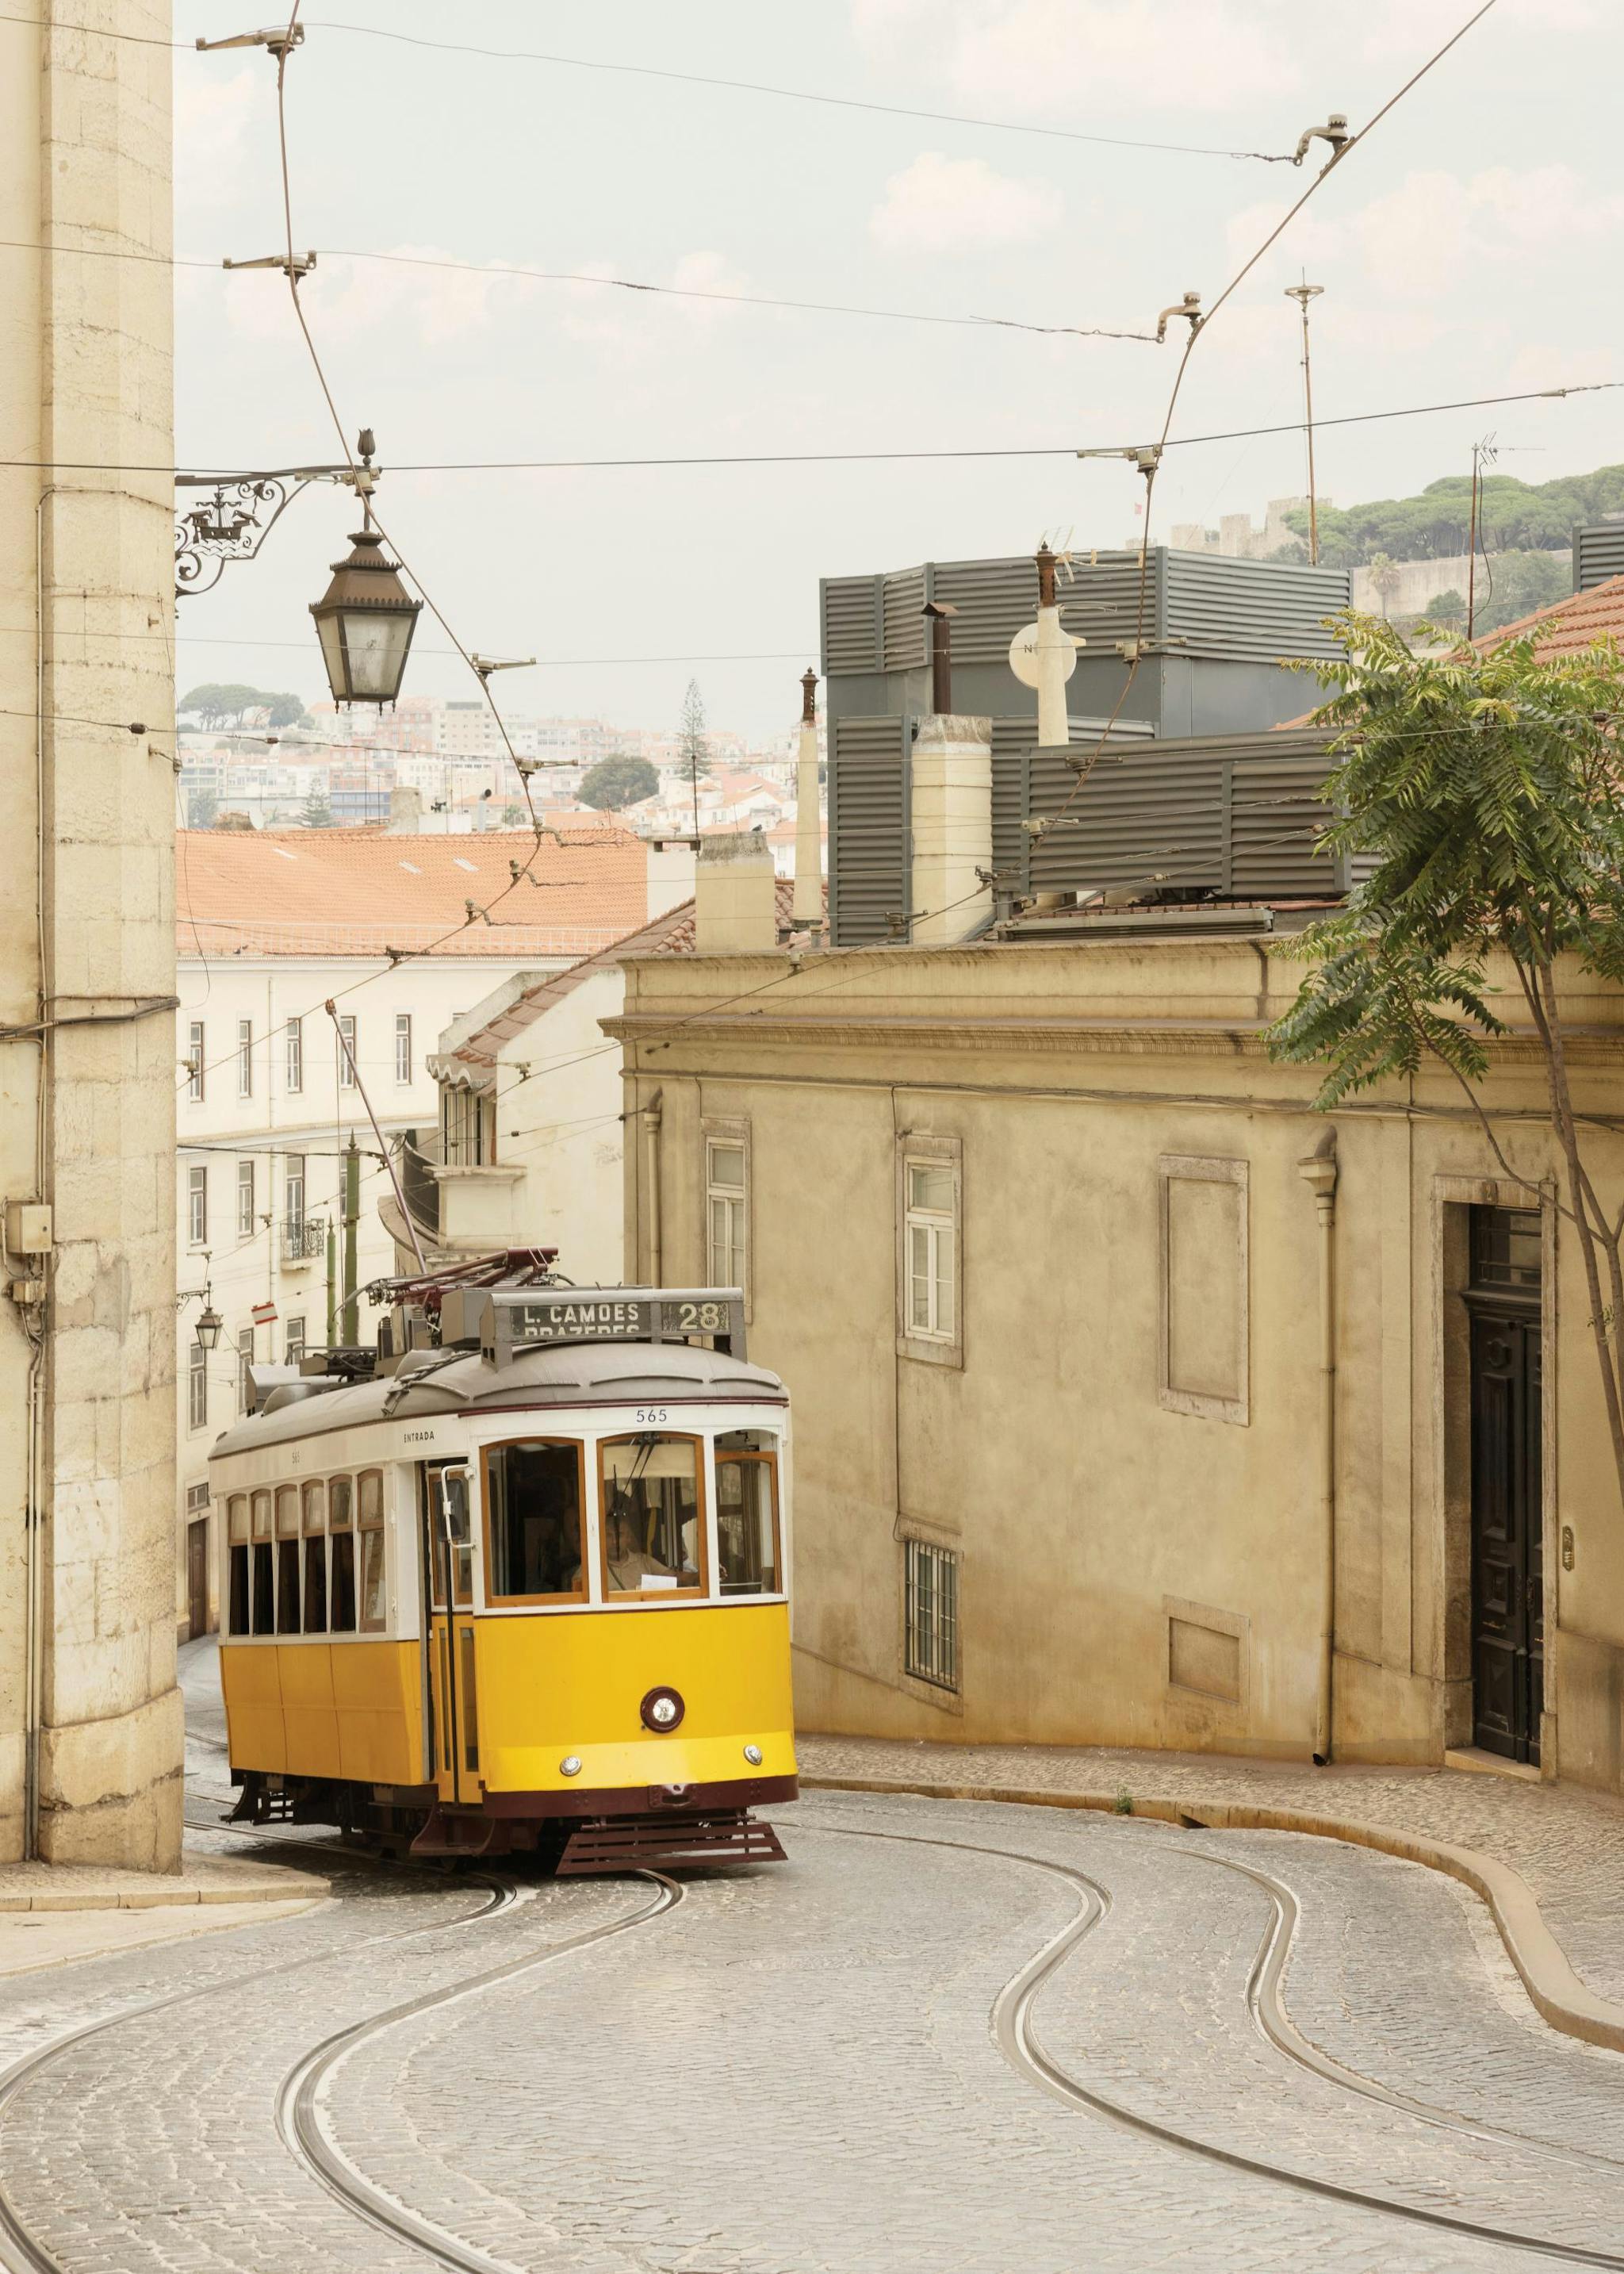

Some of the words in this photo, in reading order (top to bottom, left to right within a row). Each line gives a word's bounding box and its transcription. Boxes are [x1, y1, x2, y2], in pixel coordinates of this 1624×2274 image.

[524, 1306, 542, 1324] L.
[679, 1302, 720, 1330] 28
[637, 1409, 667, 1423] 565
[404, 1430, 435, 1444] ENTRADA
